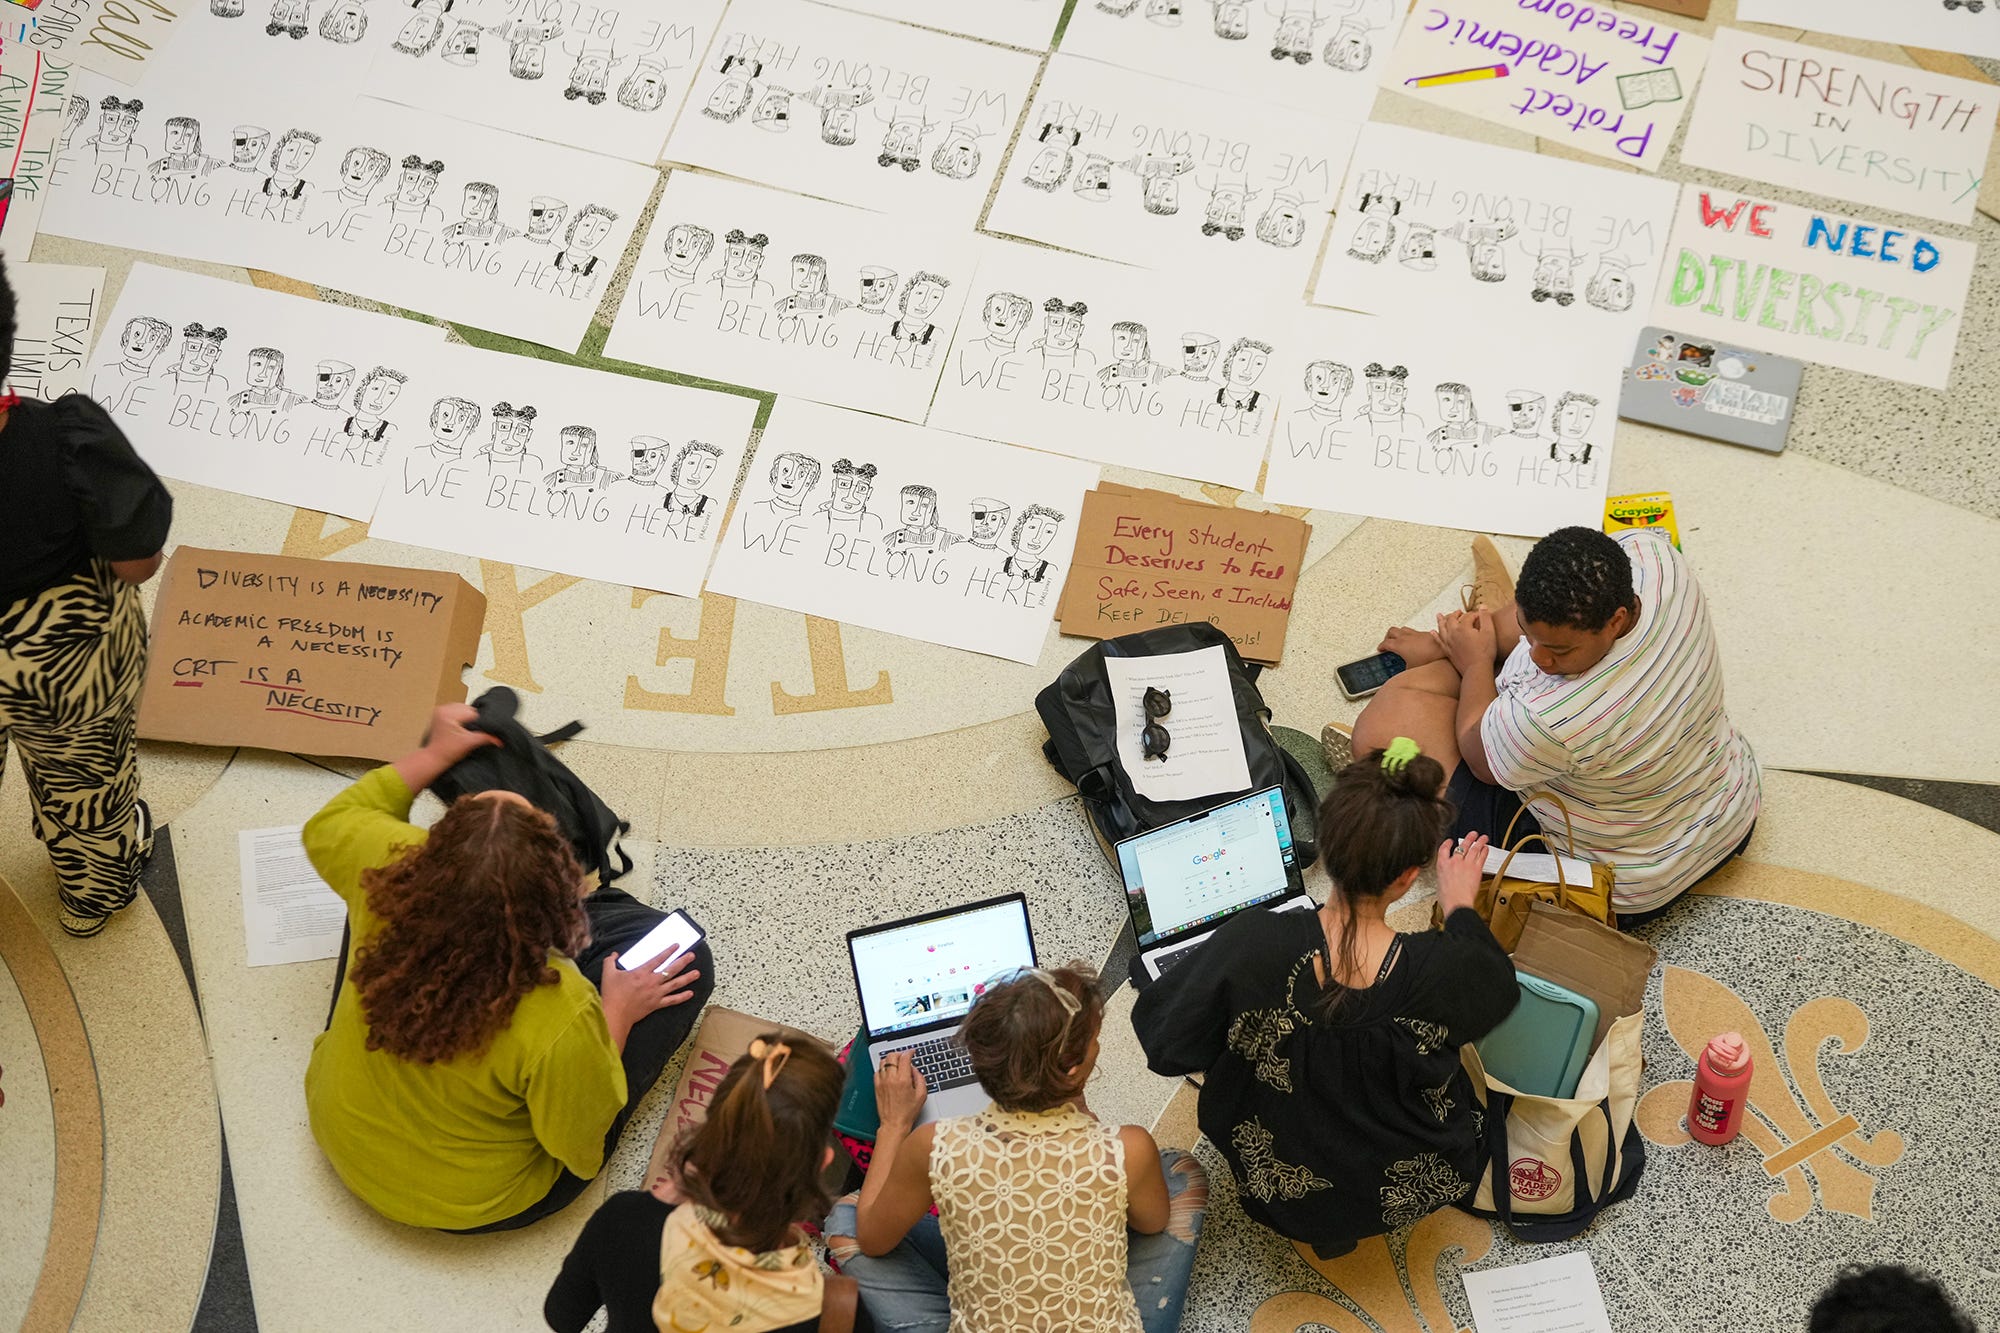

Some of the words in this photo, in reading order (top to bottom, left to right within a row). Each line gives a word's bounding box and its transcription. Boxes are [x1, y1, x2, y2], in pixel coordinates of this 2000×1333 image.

[632, 19, 695, 59] WE
[1423, 9, 1610, 85] Academic
[1518, 0, 1678, 65] Freedom
[813, 56, 930, 105] BELONG
[1740, 49, 1982, 132] STRENGTH
[944, 86, 1007, 126] WE
[1510, 87, 1654, 158] Protect
[1812, 111, 1850, 132] IN
[13, 137, 55, 201] TAKE
[1132, 124, 1250, 173] BELONG
[1745, 122, 1982, 204] DIVERSITY
[91, 163, 211, 207] BELONG
[1266, 152, 1329, 194] WE
[1451, 190, 1571, 237] BELONG
[1591, 215, 1654, 256] WE
[1699, 192, 1776, 239] WE
[1804, 214, 1942, 273] NEED
[308, 206, 372, 242] WE
[383, 222, 502, 275] BELONG
[638, 281, 702, 321] WE
[717, 300, 839, 348] BELONG
[1668, 247, 1957, 360] DIVERSITY
[48, 288, 95, 372] TEXAS
[7, 338, 47, 398] LIMIT
[960, 350, 1024, 391] WE
[1041, 369, 1163, 416] BELONG
[90, 374, 156, 416] WE
[168, 394, 290, 444] BELONG
[1288, 421, 1352, 461] WE
[1374, 434, 1498, 477] BELONG
[404, 457, 469, 499] WE
[485, 474, 610, 522] BELONG
[1613, 505, 1662, 517] Crayola
[743, 512, 808, 555] WE
[824, 533, 949, 585] BELONG
[1104, 545, 1205, 571] Deserves
[1220, 557, 1241, 575] to
[1113, 516, 1174, 556] Every
[1188, 524, 1274, 558] student
[197, 568, 299, 597] DIVERSITY
[310, 581, 325, 595] IS
[337, 580, 351, 595] A
[357, 583, 443, 613] NECESSITY
[1096, 576, 1148, 600] Safe,
[1152, 580, 1205, 601] Seen,
[178, 610, 268, 630] ACADEMIC
[277, 617, 366, 643] FREEDOM
[377, 630, 394, 643] IS
[1097, 602, 1144, 622] KEEP
[1207, 613, 1220, 625] in
[257, 635, 274, 648] A
[291, 639, 403, 669] NECESSITY
[1231, 631, 1261, 645] ools!
[172, 658, 238, 677] CRT
[248, 667, 268, 682] IS
[286, 668, 302, 684] A
[266, 690, 381, 726] NECESSITY
[1192, 848, 1227, 865] Google
[1512, 1175, 1553, 1191] TRADER
[1514, 1186, 1547, 1197] JOE'S
